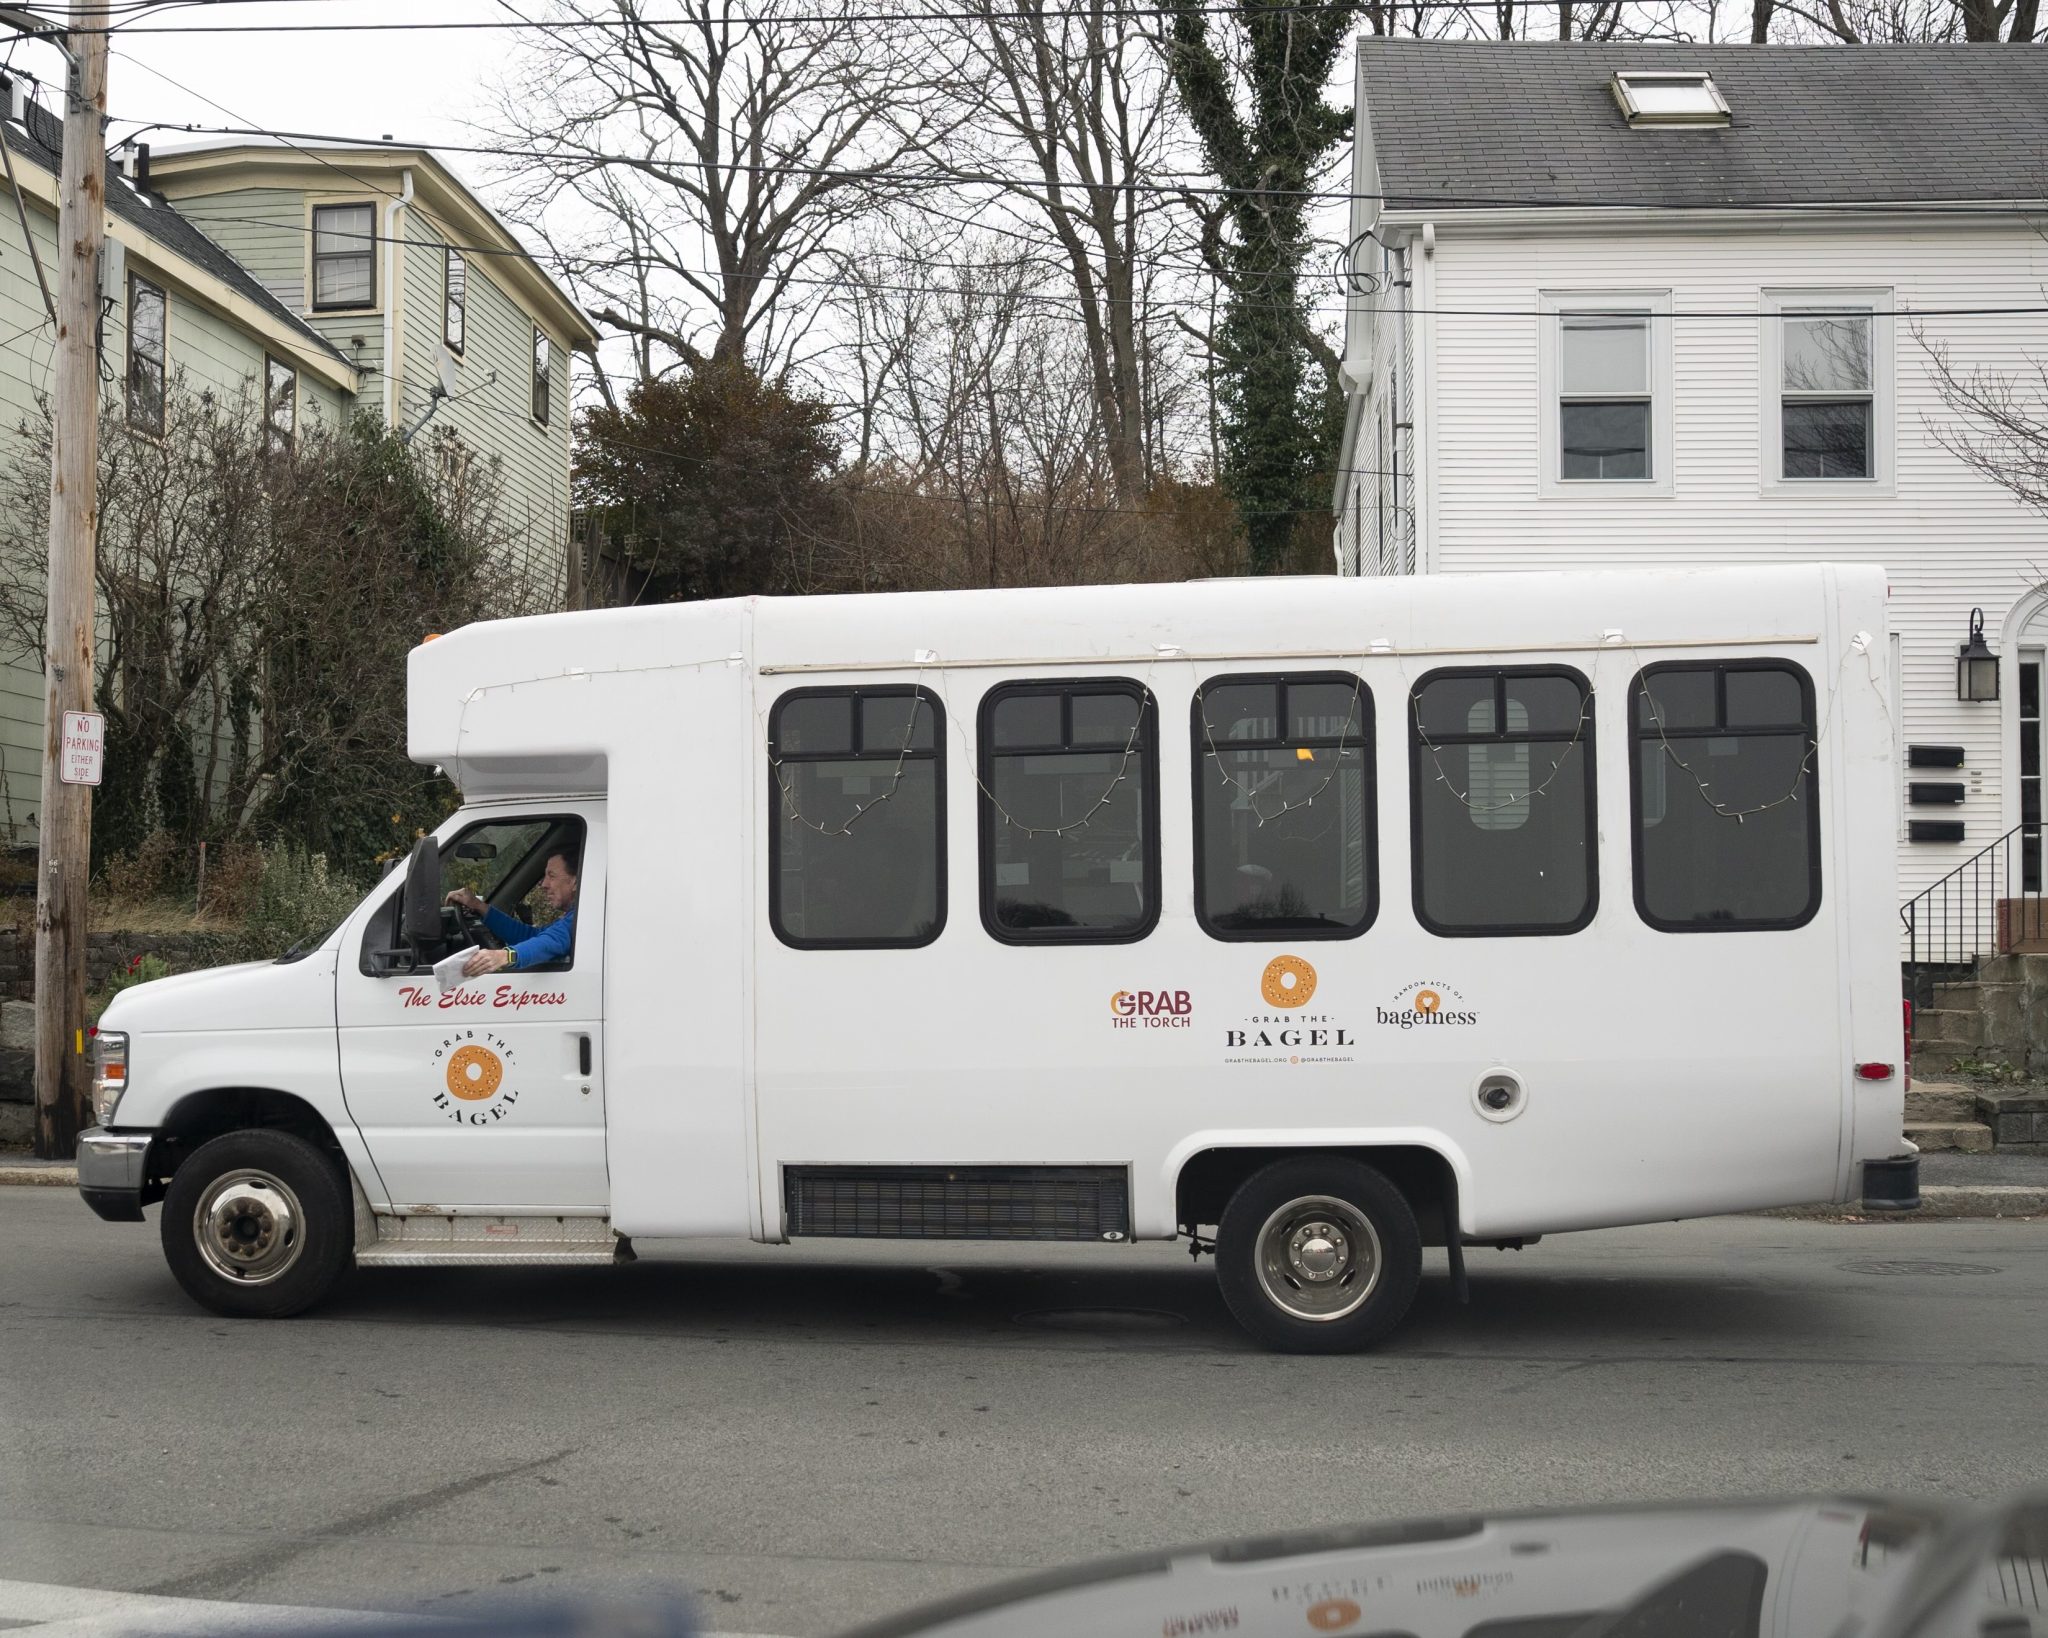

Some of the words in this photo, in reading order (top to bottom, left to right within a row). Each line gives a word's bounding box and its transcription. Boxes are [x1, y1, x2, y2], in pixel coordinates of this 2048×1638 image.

[77, 719, 90, 733] NO
[66, 736, 100, 752] PARKING
[71, 754, 94, 765] EITHER
[74, 767, 90, 777] SIDE
[399, 987, 431, 1008] The
[438, 986, 486, 1009] Elsie
[493, 985, 567, 1011] Express
[1394, 981, 1426, 1001] RANDOM
[1430, 981, 1451, 991] ACTS
[1453, 990, 1463, 1000] OF
[1110, 990, 1192, 1017] GRAB
[1112, 1017, 1137, 1028] THE
[1142, 1016, 1190, 1028] TORCH
[1301, 1015, 1327, 1023] THE
[434, 1030, 474, 1058] GRAB
[487, 1033, 514, 1058] THE
[1226, 1029, 1355, 1047] BAGEL
[432, 1090, 519, 1126] BAGEL
